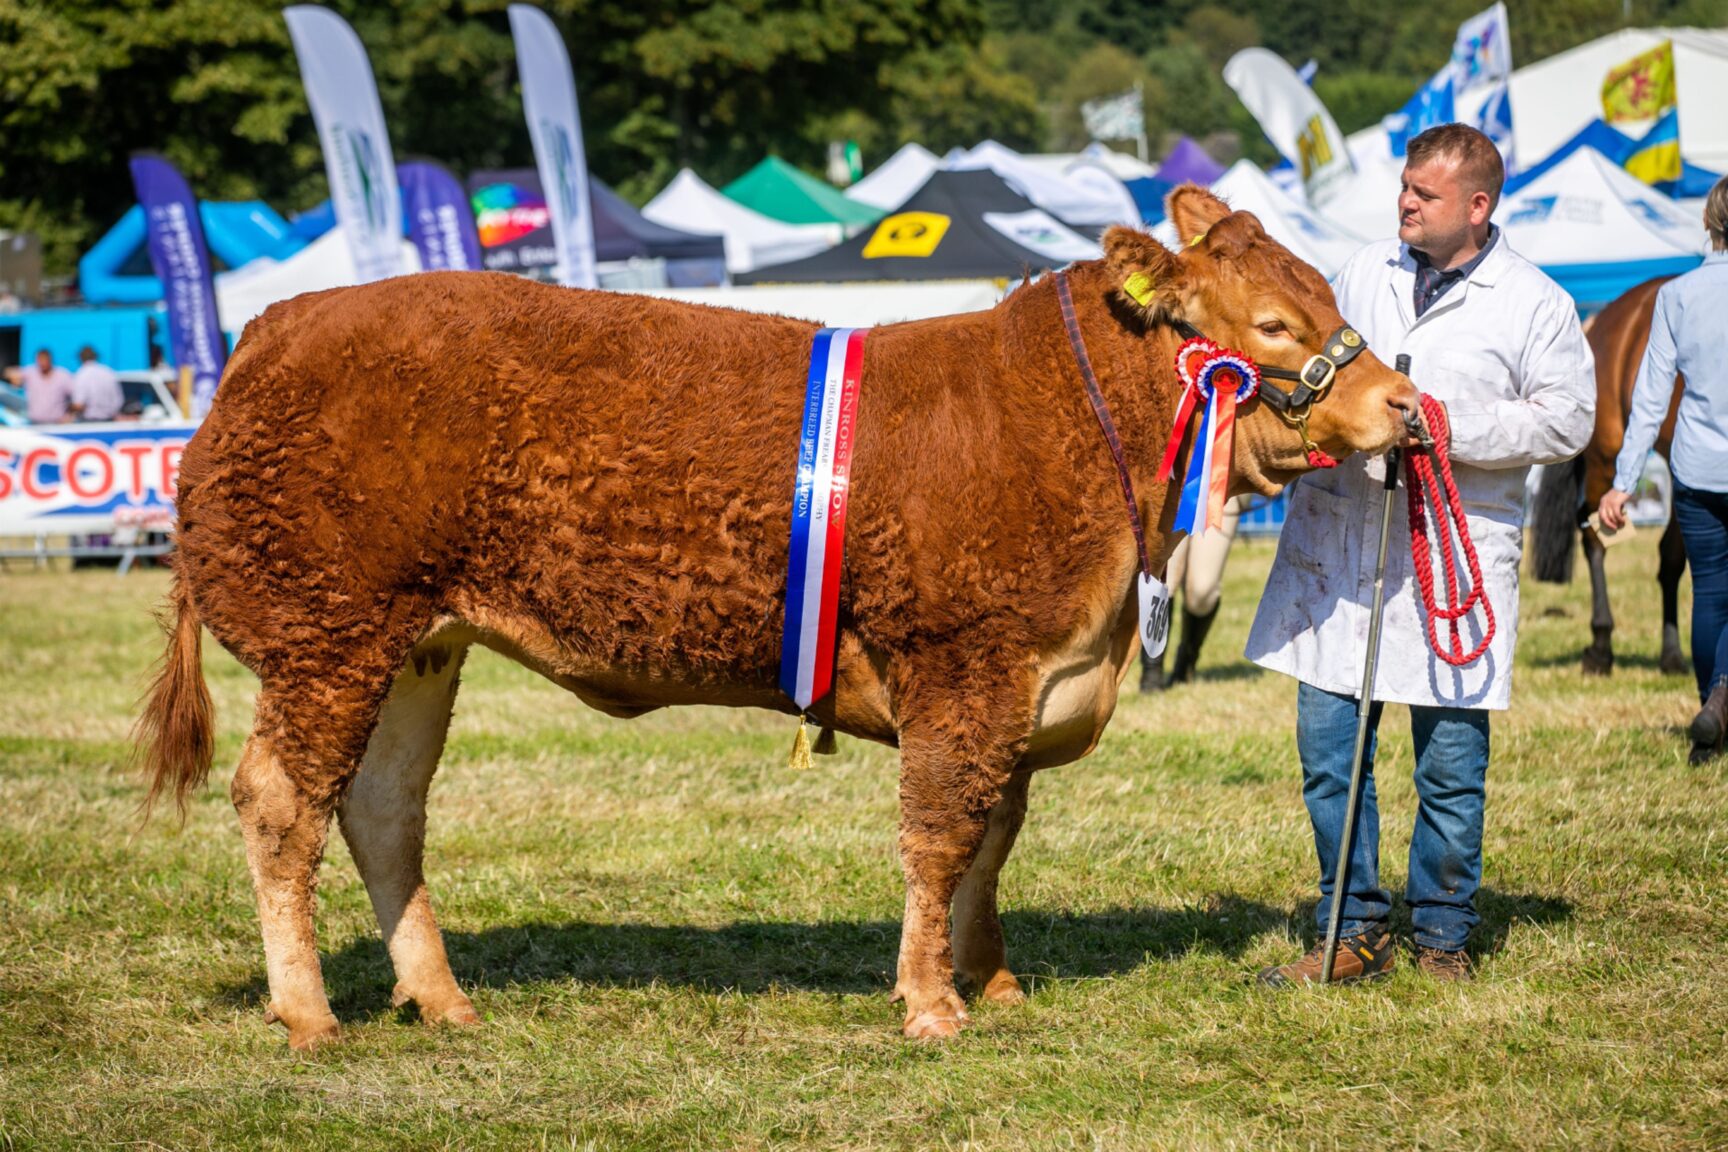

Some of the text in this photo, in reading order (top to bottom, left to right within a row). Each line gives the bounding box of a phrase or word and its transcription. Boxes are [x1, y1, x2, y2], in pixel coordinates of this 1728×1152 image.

[824, 396, 836, 435] CHAPMAN
[829, 379, 837, 396] THE
[798, 380, 821, 518] INTERBREED BEEF CAMPION
[831, 379, 856, 530] KINROSS SHOW
